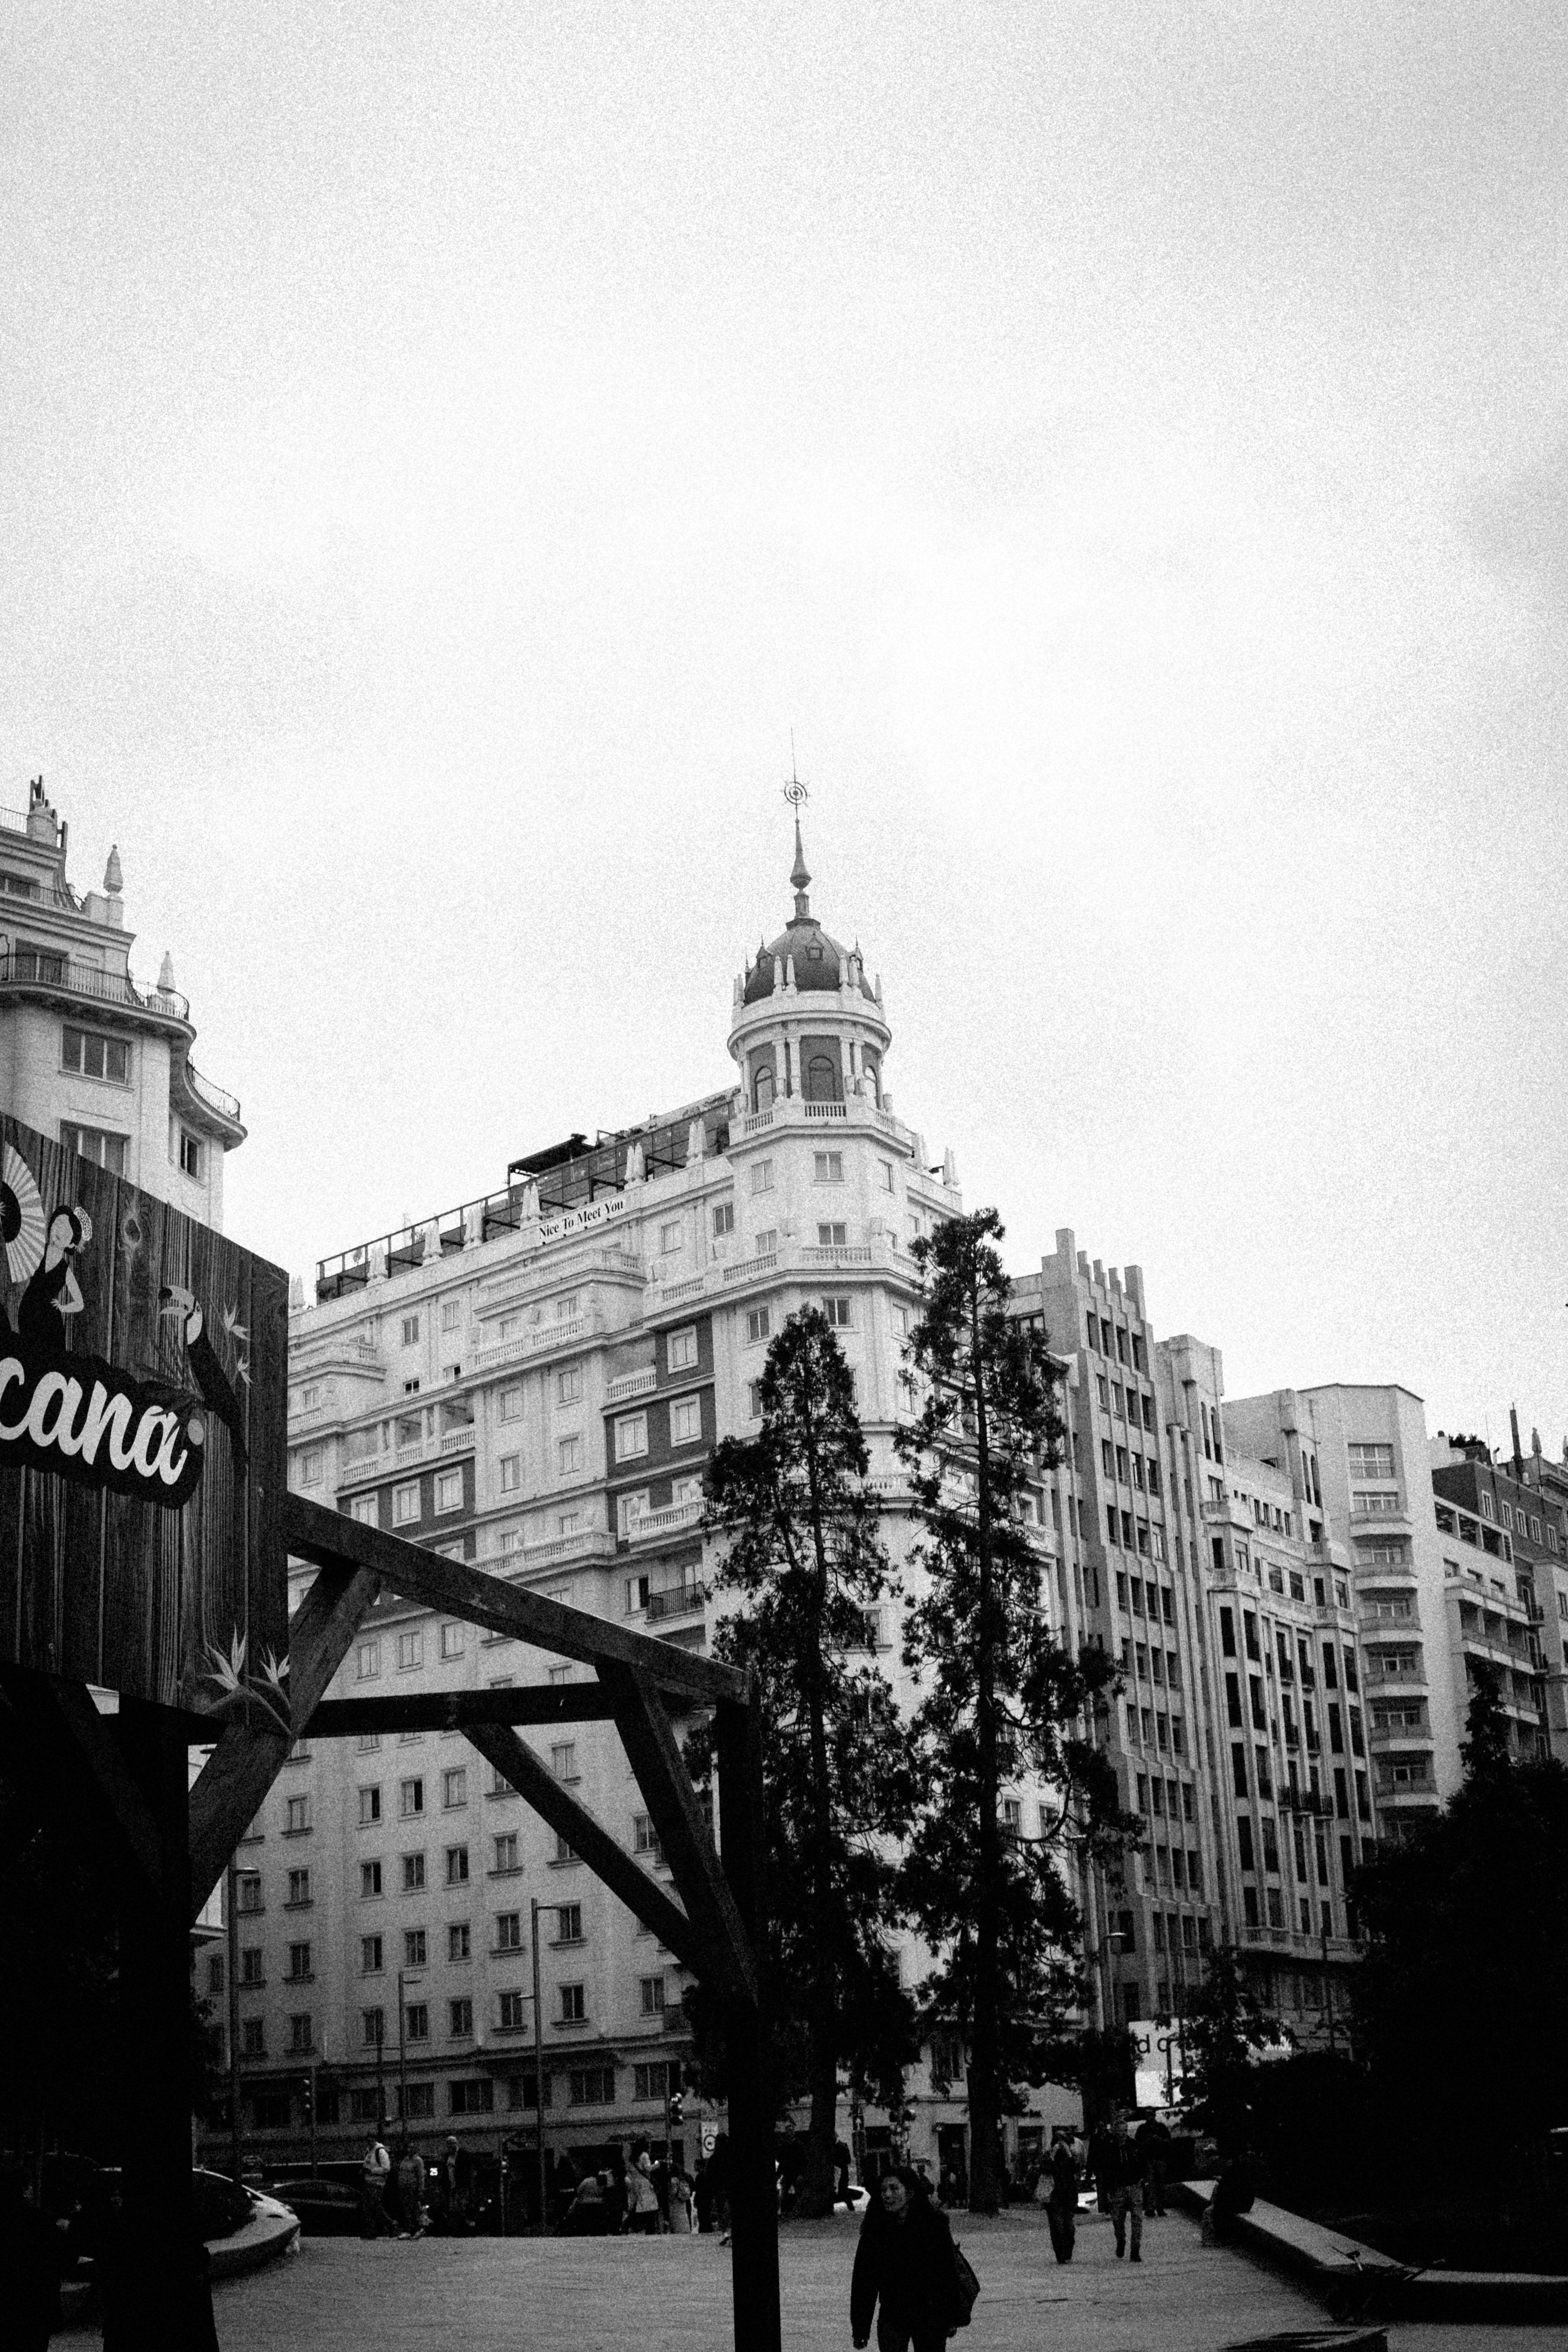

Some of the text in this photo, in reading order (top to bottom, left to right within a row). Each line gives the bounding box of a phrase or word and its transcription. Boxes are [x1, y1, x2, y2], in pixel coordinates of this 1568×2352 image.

[539, 1201, 623, 1239] Nice To Meet You
